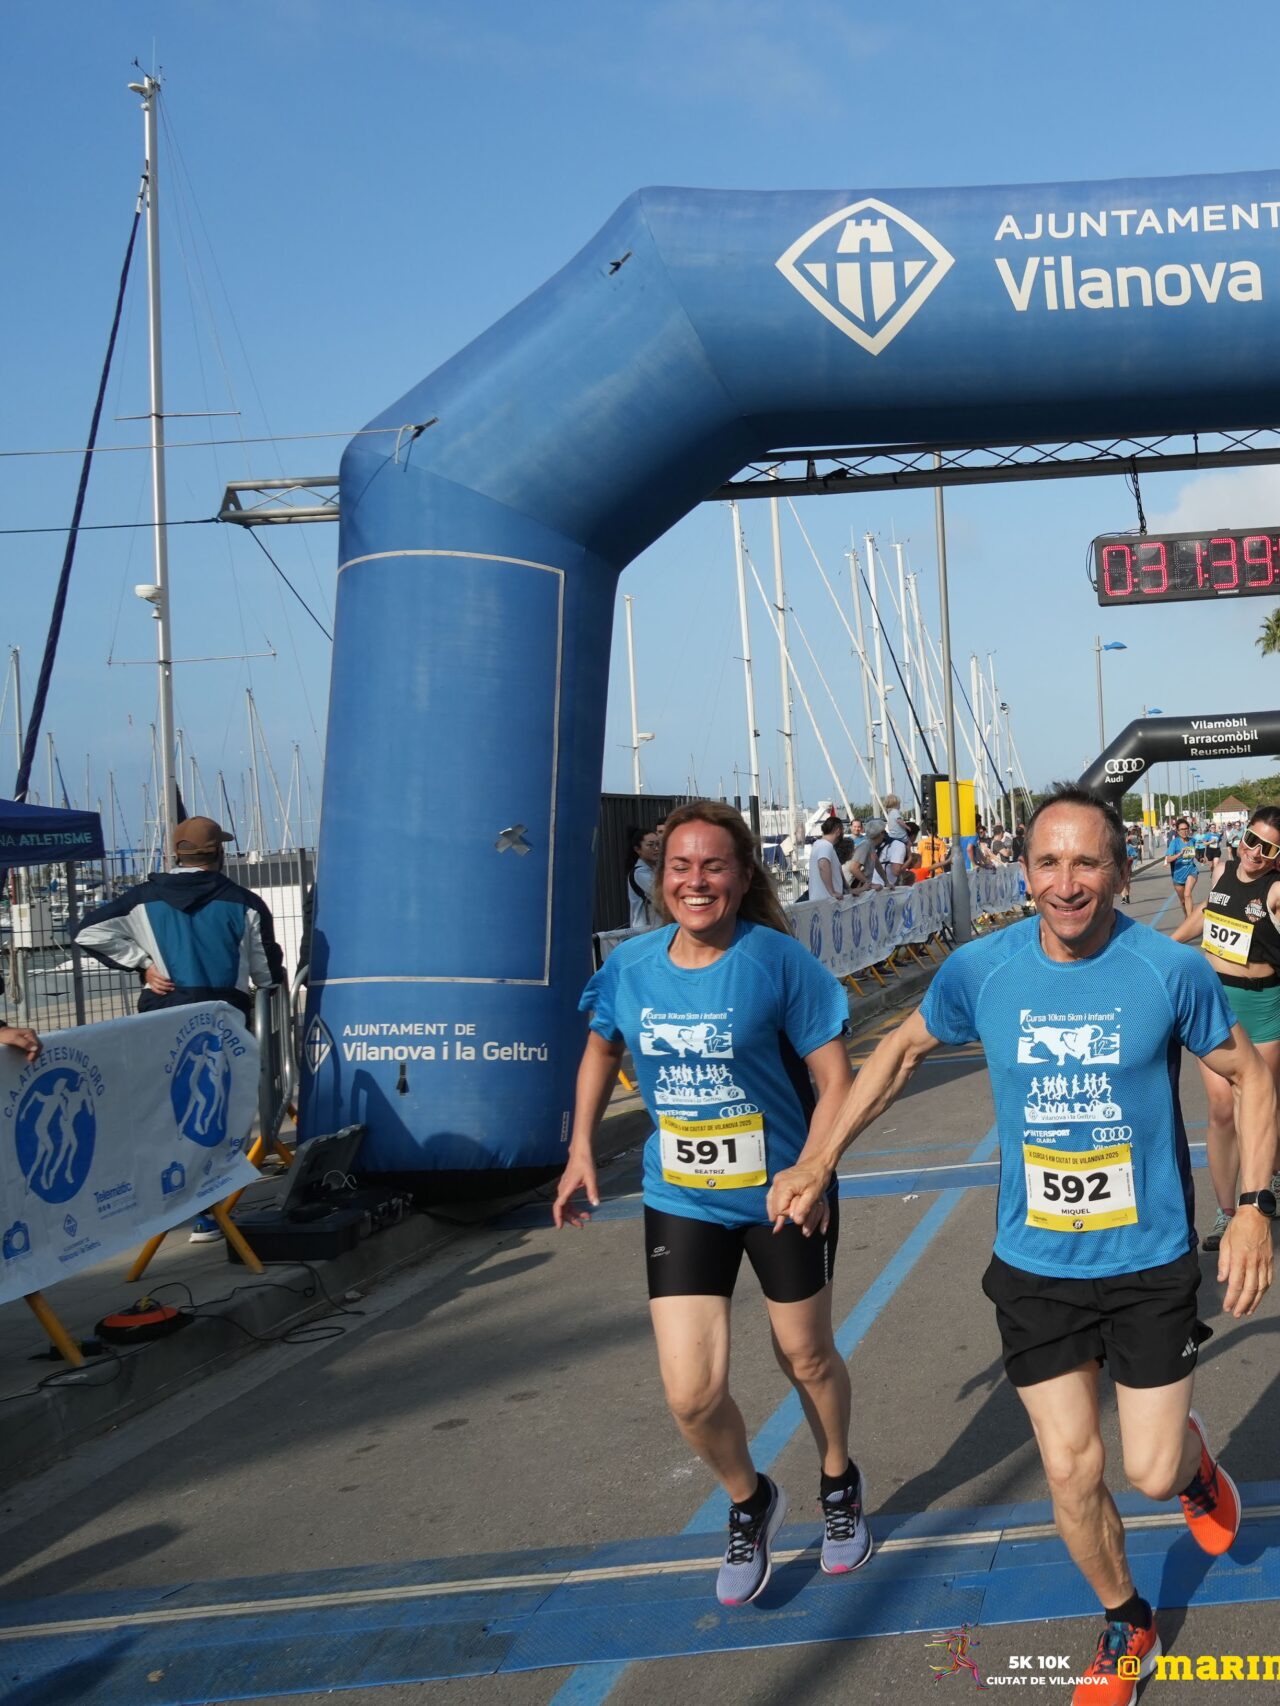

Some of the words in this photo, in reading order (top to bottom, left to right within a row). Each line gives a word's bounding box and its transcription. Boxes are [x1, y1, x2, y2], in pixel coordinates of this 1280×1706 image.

[994, 256, 1264, 312] Vilanova
[1190, 717, 1248, 730] Vilamòbil
[1181, 729, 1259, 745] Tarracomòbil
[1189, 744, 1252, 757] Reusmòbil
[1104, 774, 1124, 784] Audi
[19, 832, 93, 847] ATLETISME
[1210, 923, 1241, 946] 507
[343, 1023, 448, 1037] AJUNTAMENT
[454, 1023, 476, 1036] DE
[343, 1041, 436, 1062] Vilanova
[442, 1041, 449, 1061] i
[455, 1041, 476, 1061] la
[482, 1041, 548, 1062] Geltrú
[676, 1138, 737, 1165] 591
[1080, 1153, 1105, 1164] VILANOVA
[1105, 1151, 1119, 1159] 2025
[1042, 1171, 1111, 1204] 592
[1061, 1207, 1091, 1216] MIQUEL
